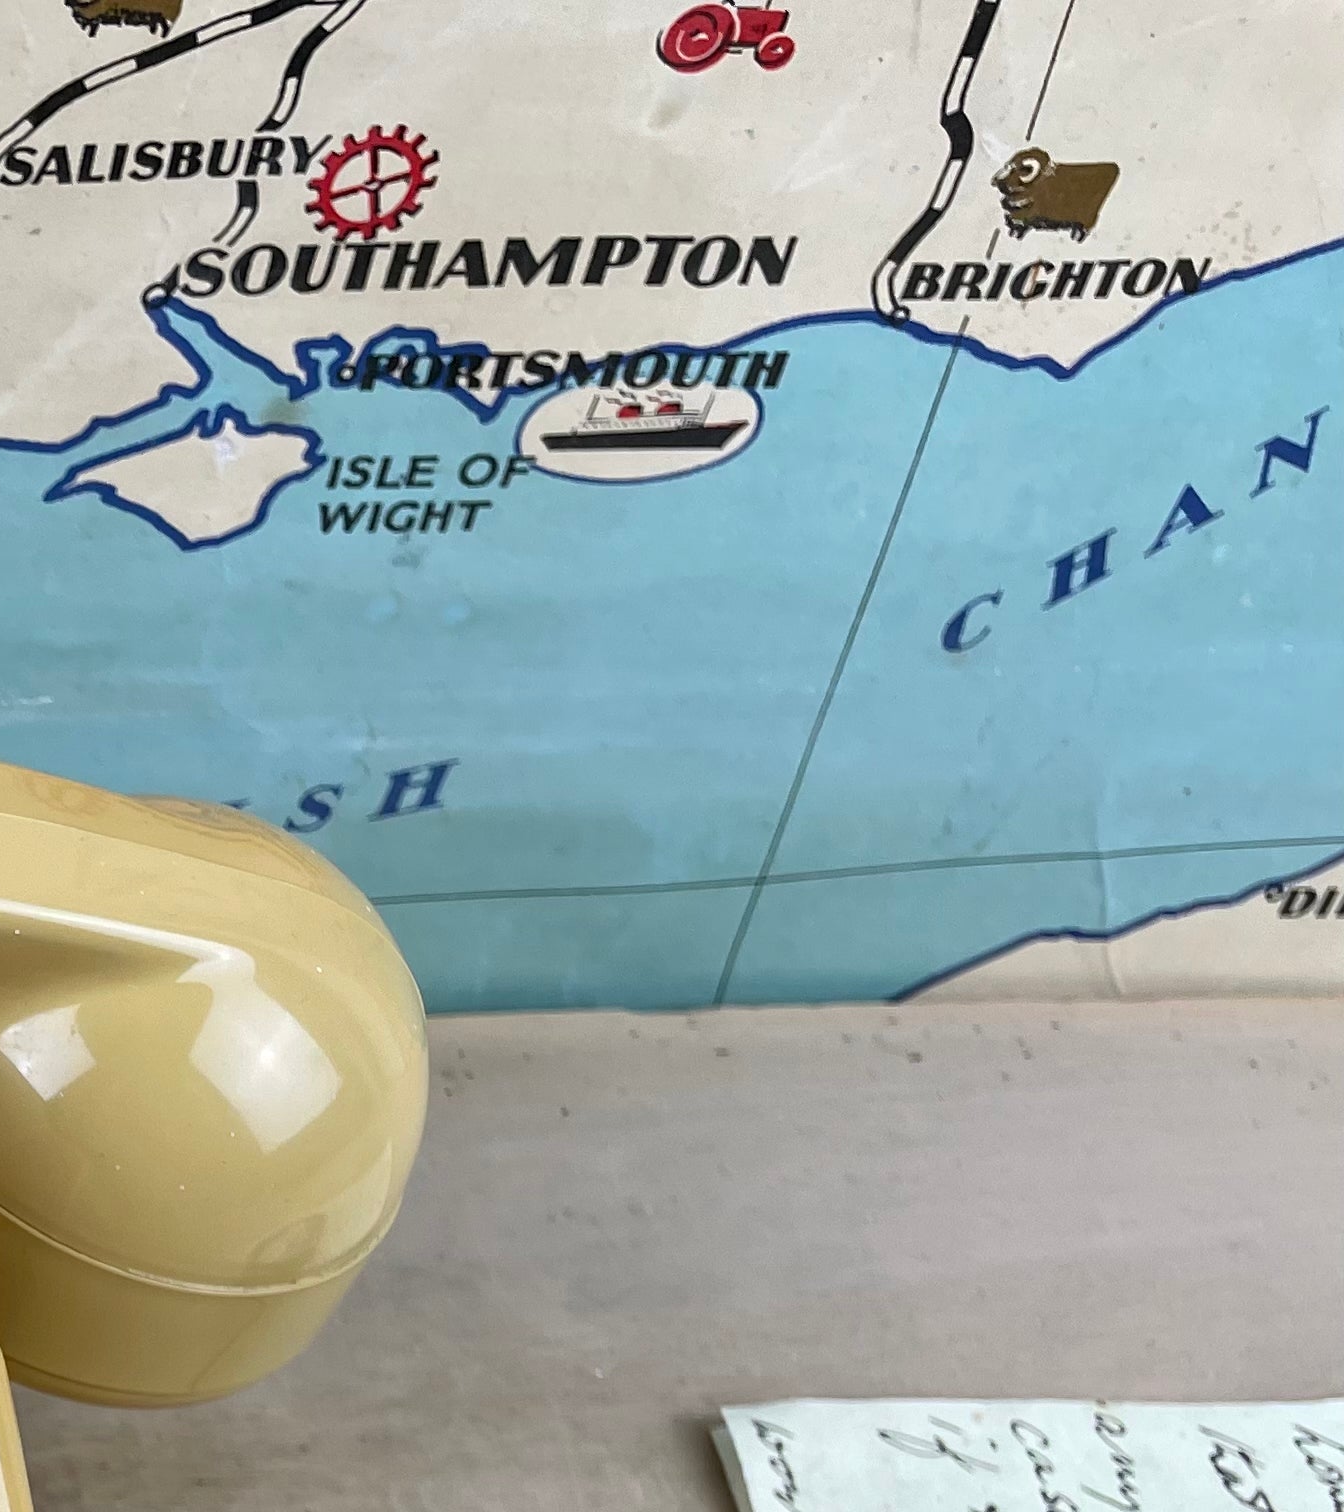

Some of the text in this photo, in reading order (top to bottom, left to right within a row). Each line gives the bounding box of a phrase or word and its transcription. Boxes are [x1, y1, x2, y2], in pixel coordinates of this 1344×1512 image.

[0, 134, 332, 186] SALISBURY
[178, 235, 798, 297] SOUTHAMPTON
[902, 257, 1214, 303] BRIGHTON
[358, 350, 790, 392] PORTSMOUTH
[325, 453, 537, 490] ISLE OF
[318, 500, 492, 535] WIGHT
